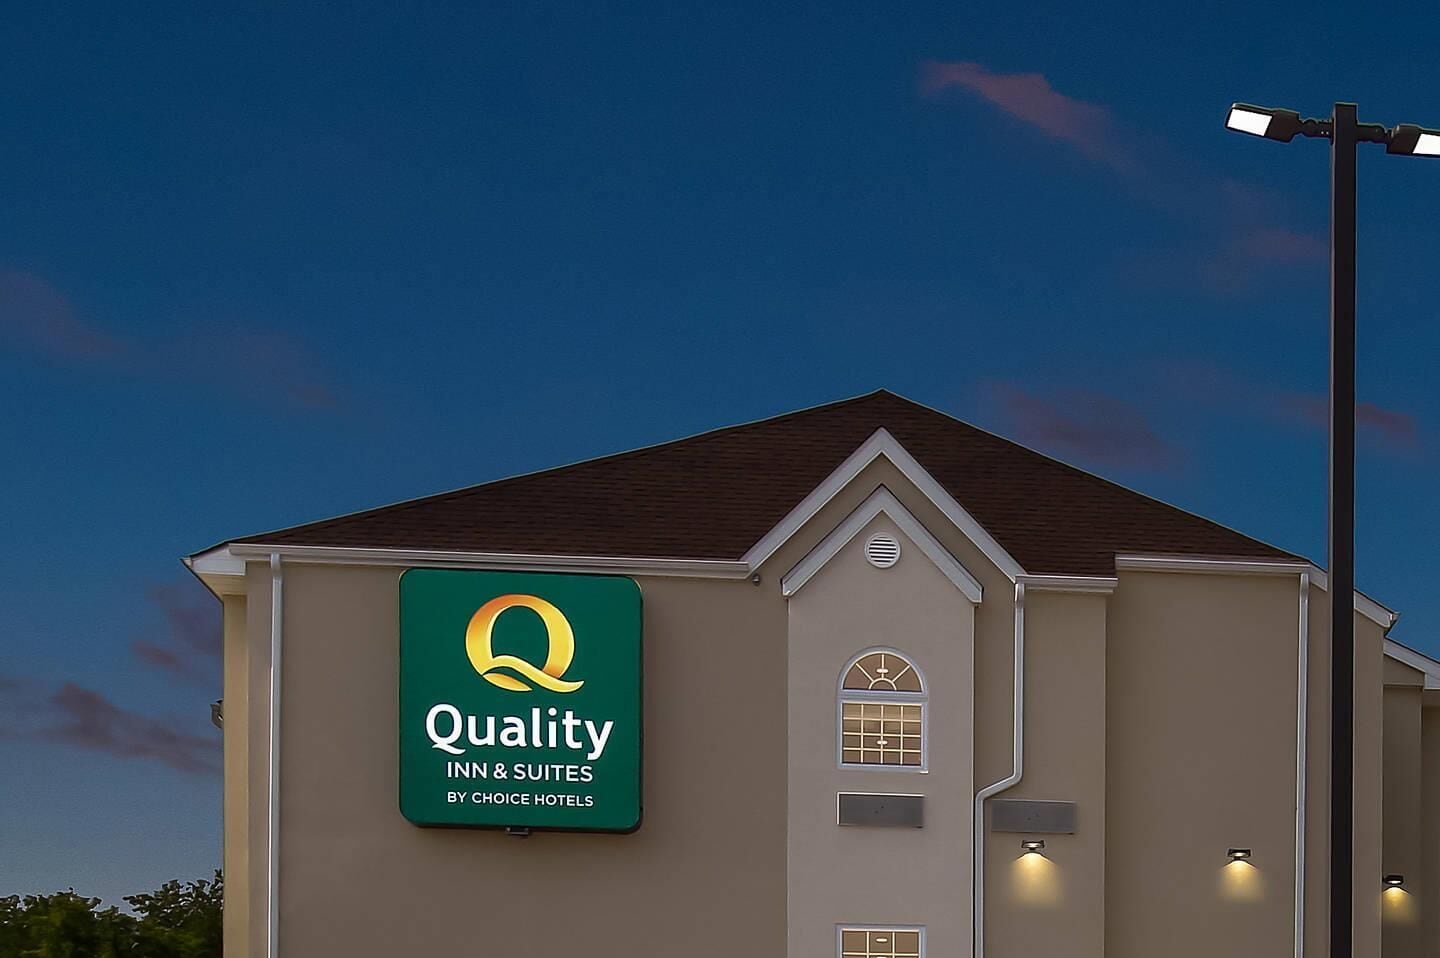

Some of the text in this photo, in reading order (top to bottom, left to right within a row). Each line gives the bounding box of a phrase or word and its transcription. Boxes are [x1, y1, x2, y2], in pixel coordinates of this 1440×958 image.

[465, 593, 585, 693] Q
[425, 703, 614, 761] Quality
[447, 762, 593, 782] INN & SUITES
[447, 791, 594, 807] BY CHOICE HOTELS
